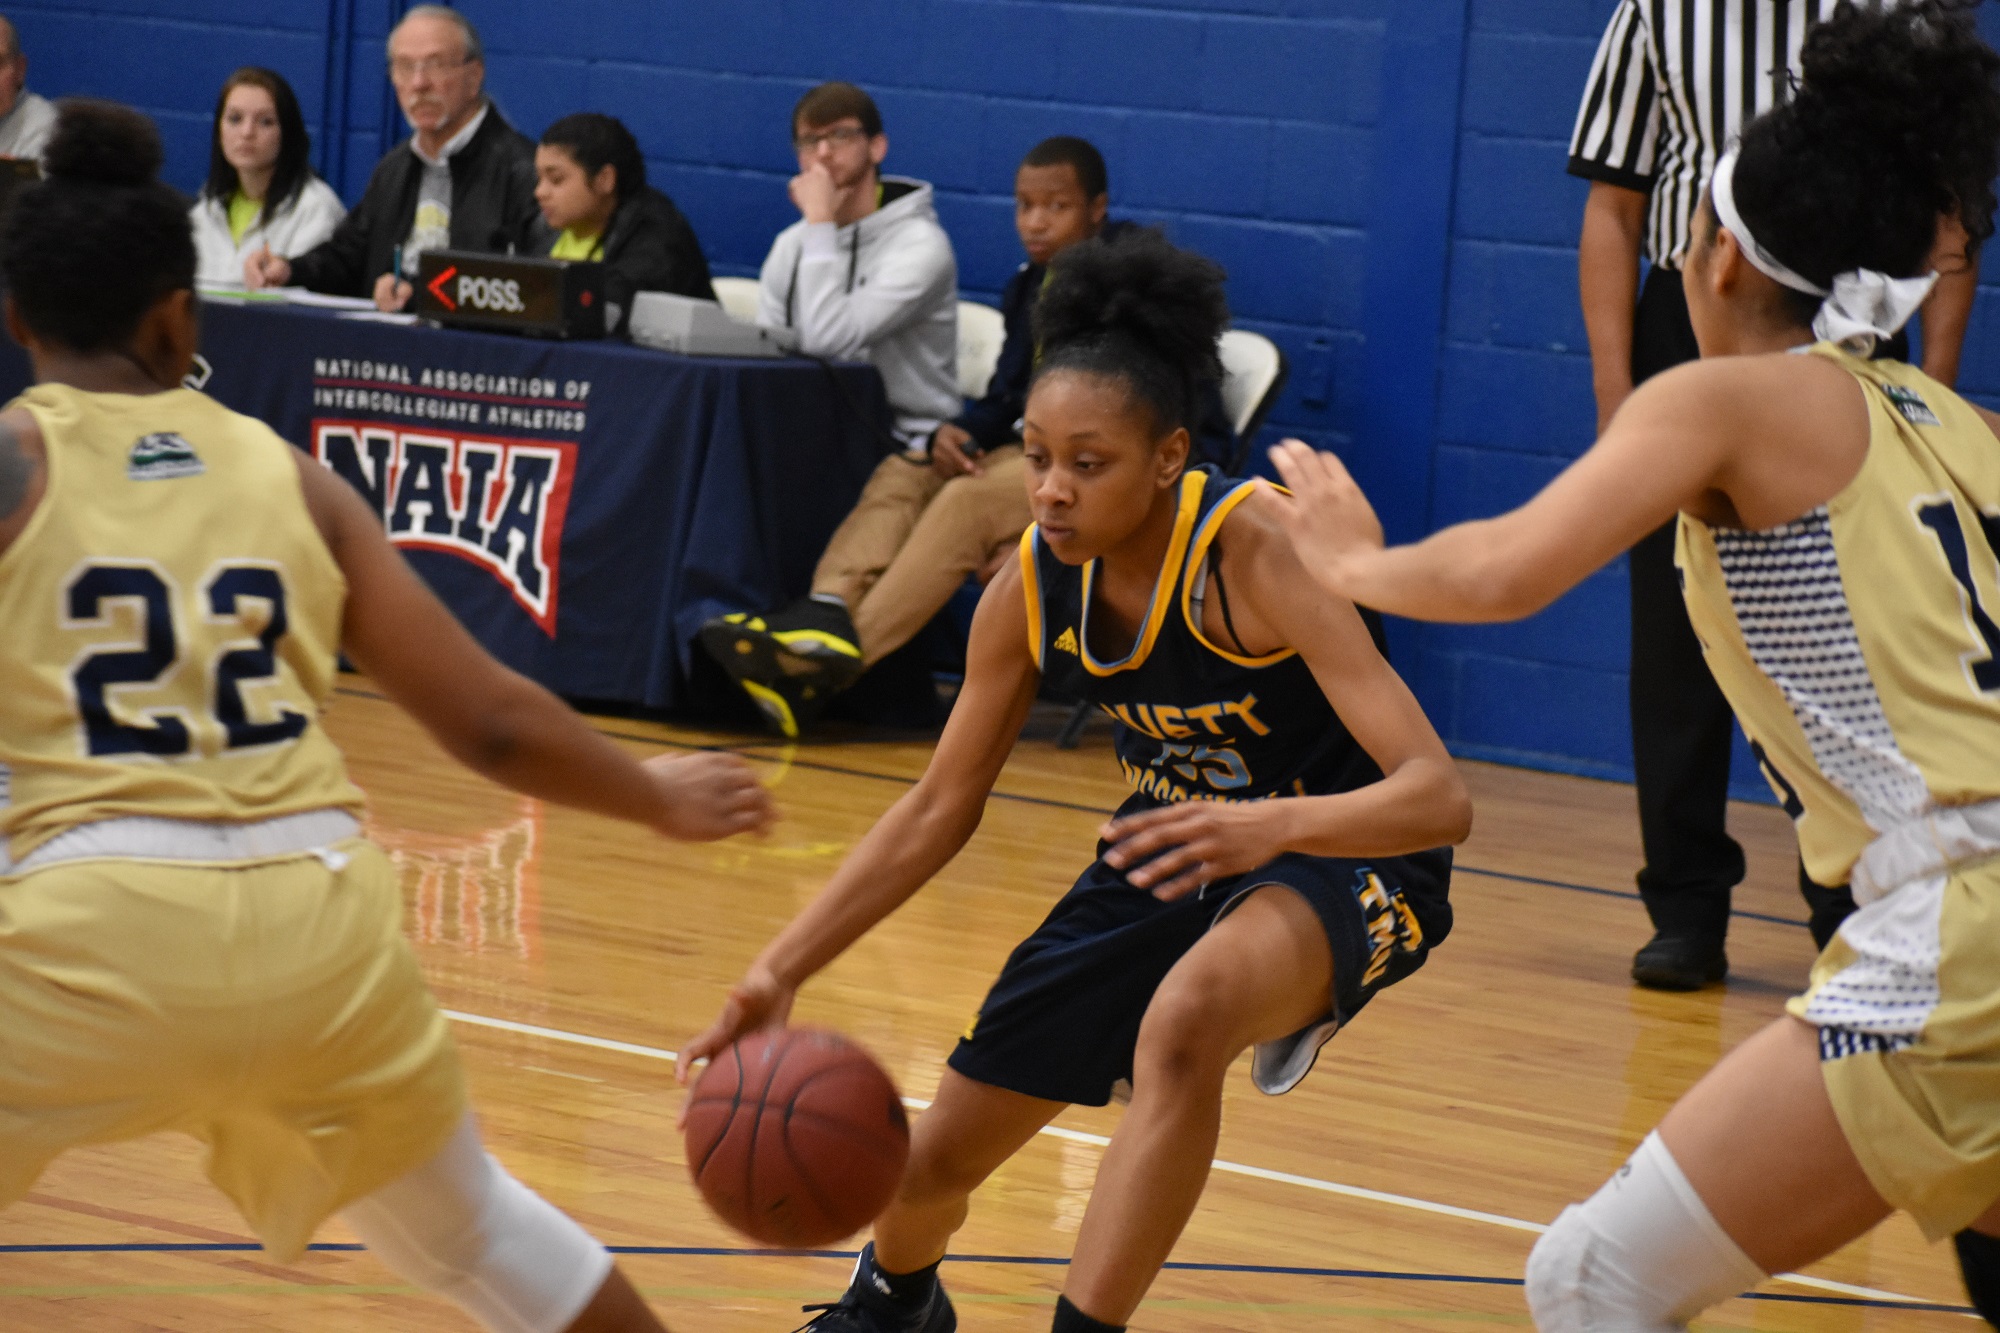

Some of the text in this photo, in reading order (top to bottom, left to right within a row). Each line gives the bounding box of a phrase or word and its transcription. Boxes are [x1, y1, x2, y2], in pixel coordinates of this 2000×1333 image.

[457, 274, 526, 312] POSS.
[314, 357, 591, 400] NATIONAL ASSOCIATION OF
[314, 387, 586, 432] INTERCOLLEGIATE ATHLETICS
[318, 425, 561, 618] NAIA
[60, 557, 308, 761] 22
